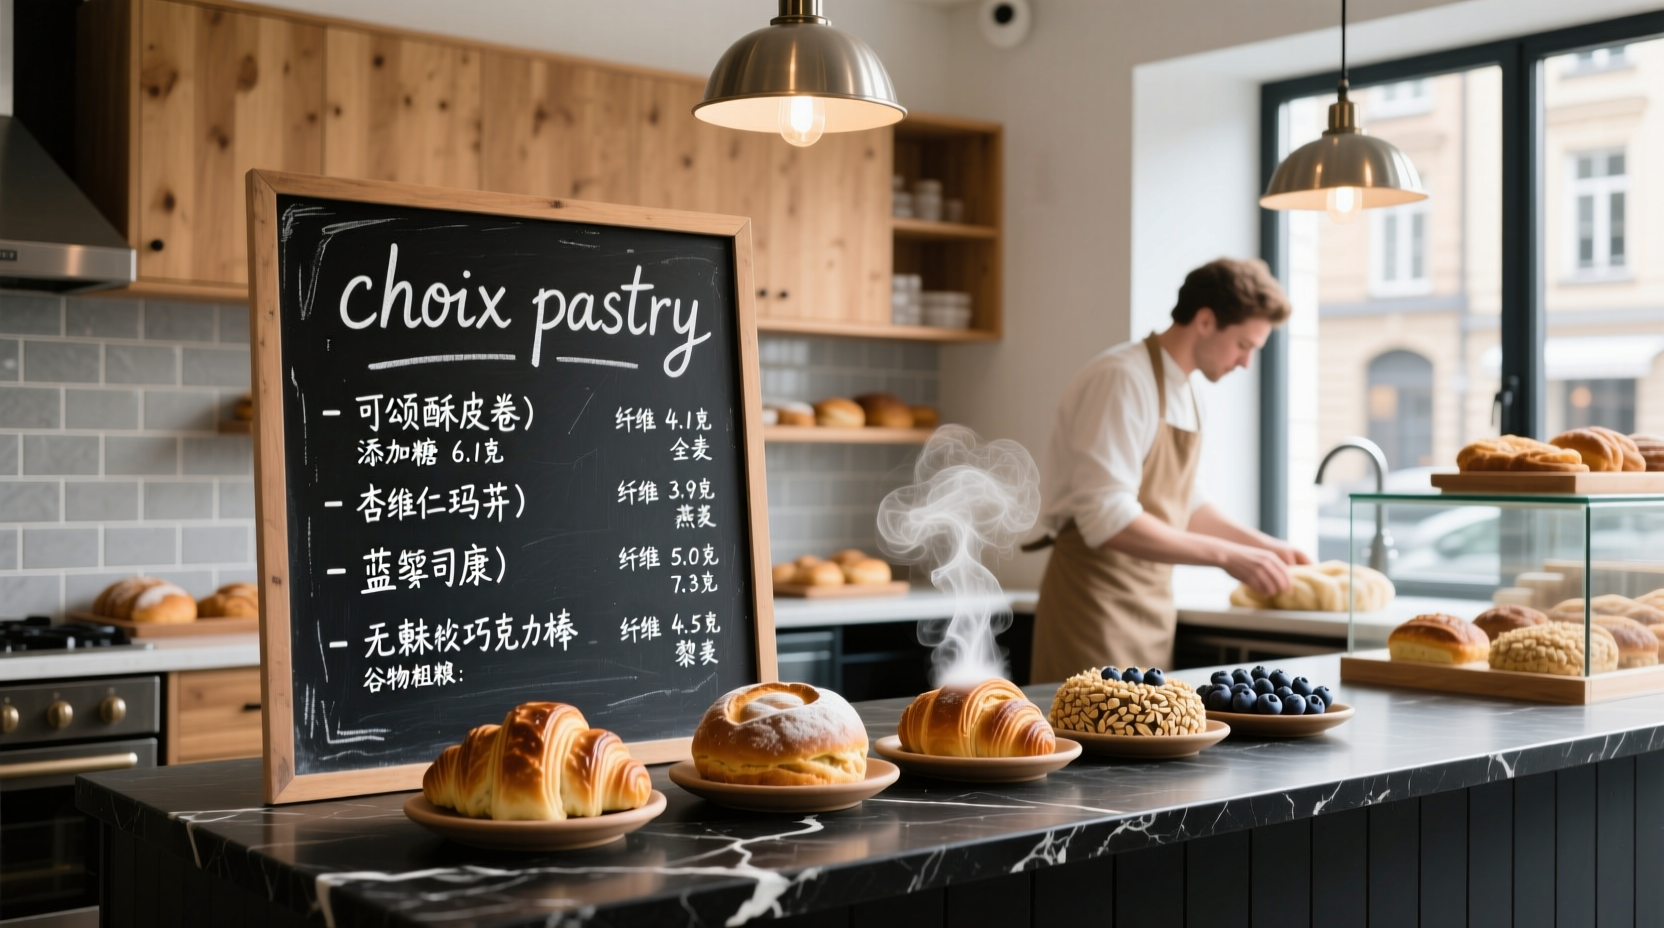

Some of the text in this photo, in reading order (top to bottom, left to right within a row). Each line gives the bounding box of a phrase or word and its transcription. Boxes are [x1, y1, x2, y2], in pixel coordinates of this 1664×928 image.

[339, 243, 712, 378] choix pastry
[615, 406, 713, 433] 纤维 4.1克
[357, 437, 504, 467] 添加糖 6.1克
[669, 433, 713, 461] 全麦
[617, 477, 716, 506] 纤维 3.9克
[618, 542, 720, 572] 纤维 5.0克
[670, 570, 718, 594] 7.3克
[619, 610, 721, 644] 纤维 4.5克
